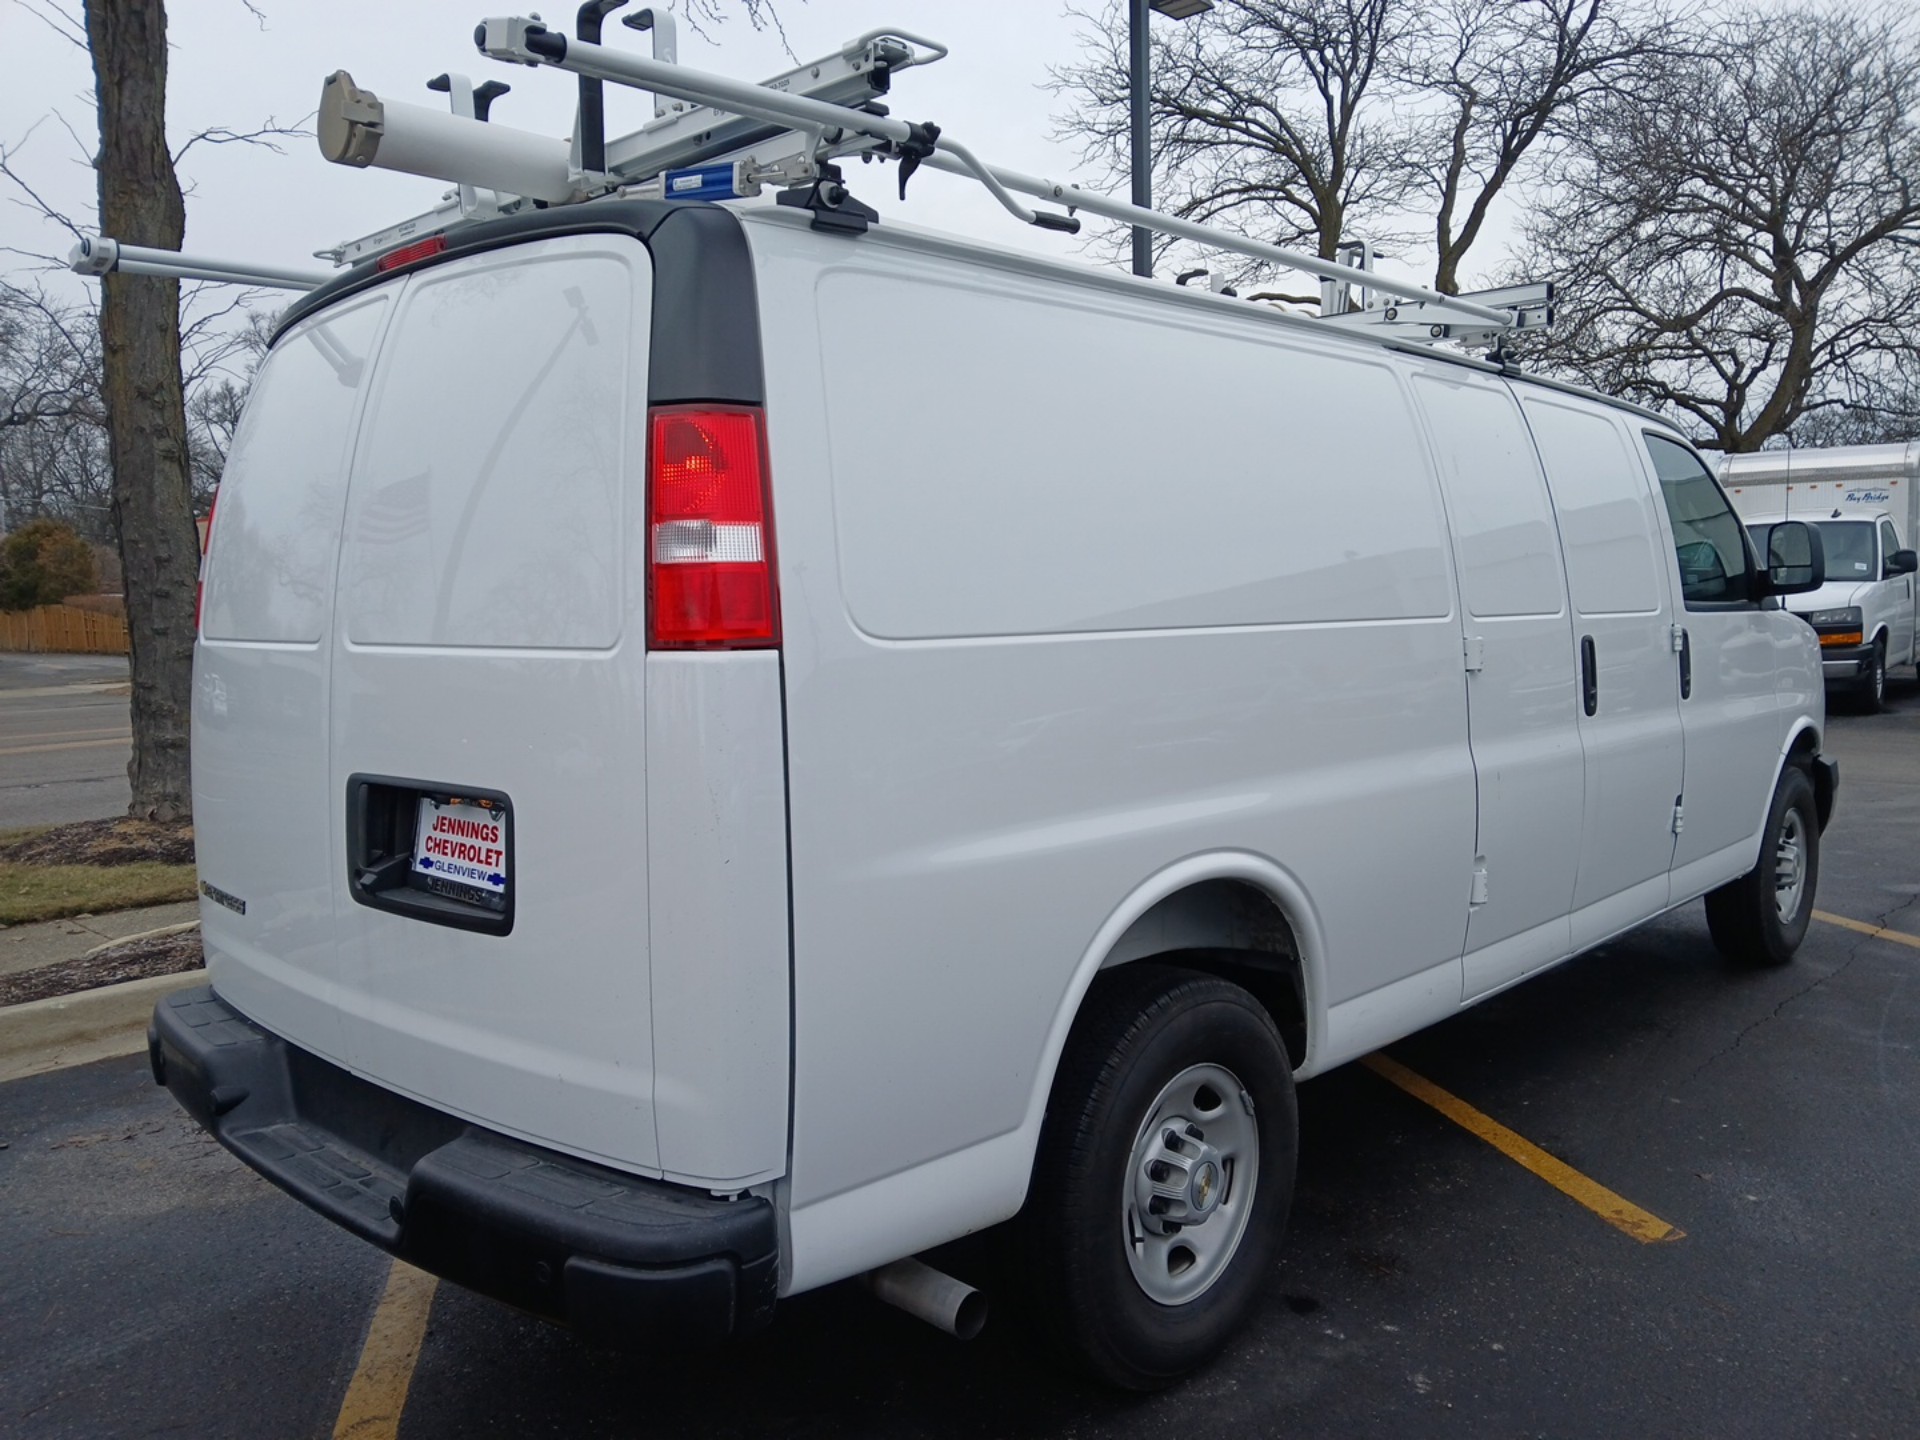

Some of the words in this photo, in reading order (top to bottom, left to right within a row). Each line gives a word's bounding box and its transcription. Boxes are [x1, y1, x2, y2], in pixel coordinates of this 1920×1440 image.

[1845, 493, 1861, 503] Bay
[1862, 492, 1889, 503] Bridge
[432, 815, 499, 843] JENNINGS
[425, 836, 503, 868] CHEVROLET
[435, 861, 487, 881] GLENVIEW
[427, 878, 481, 902] JENNINGS
